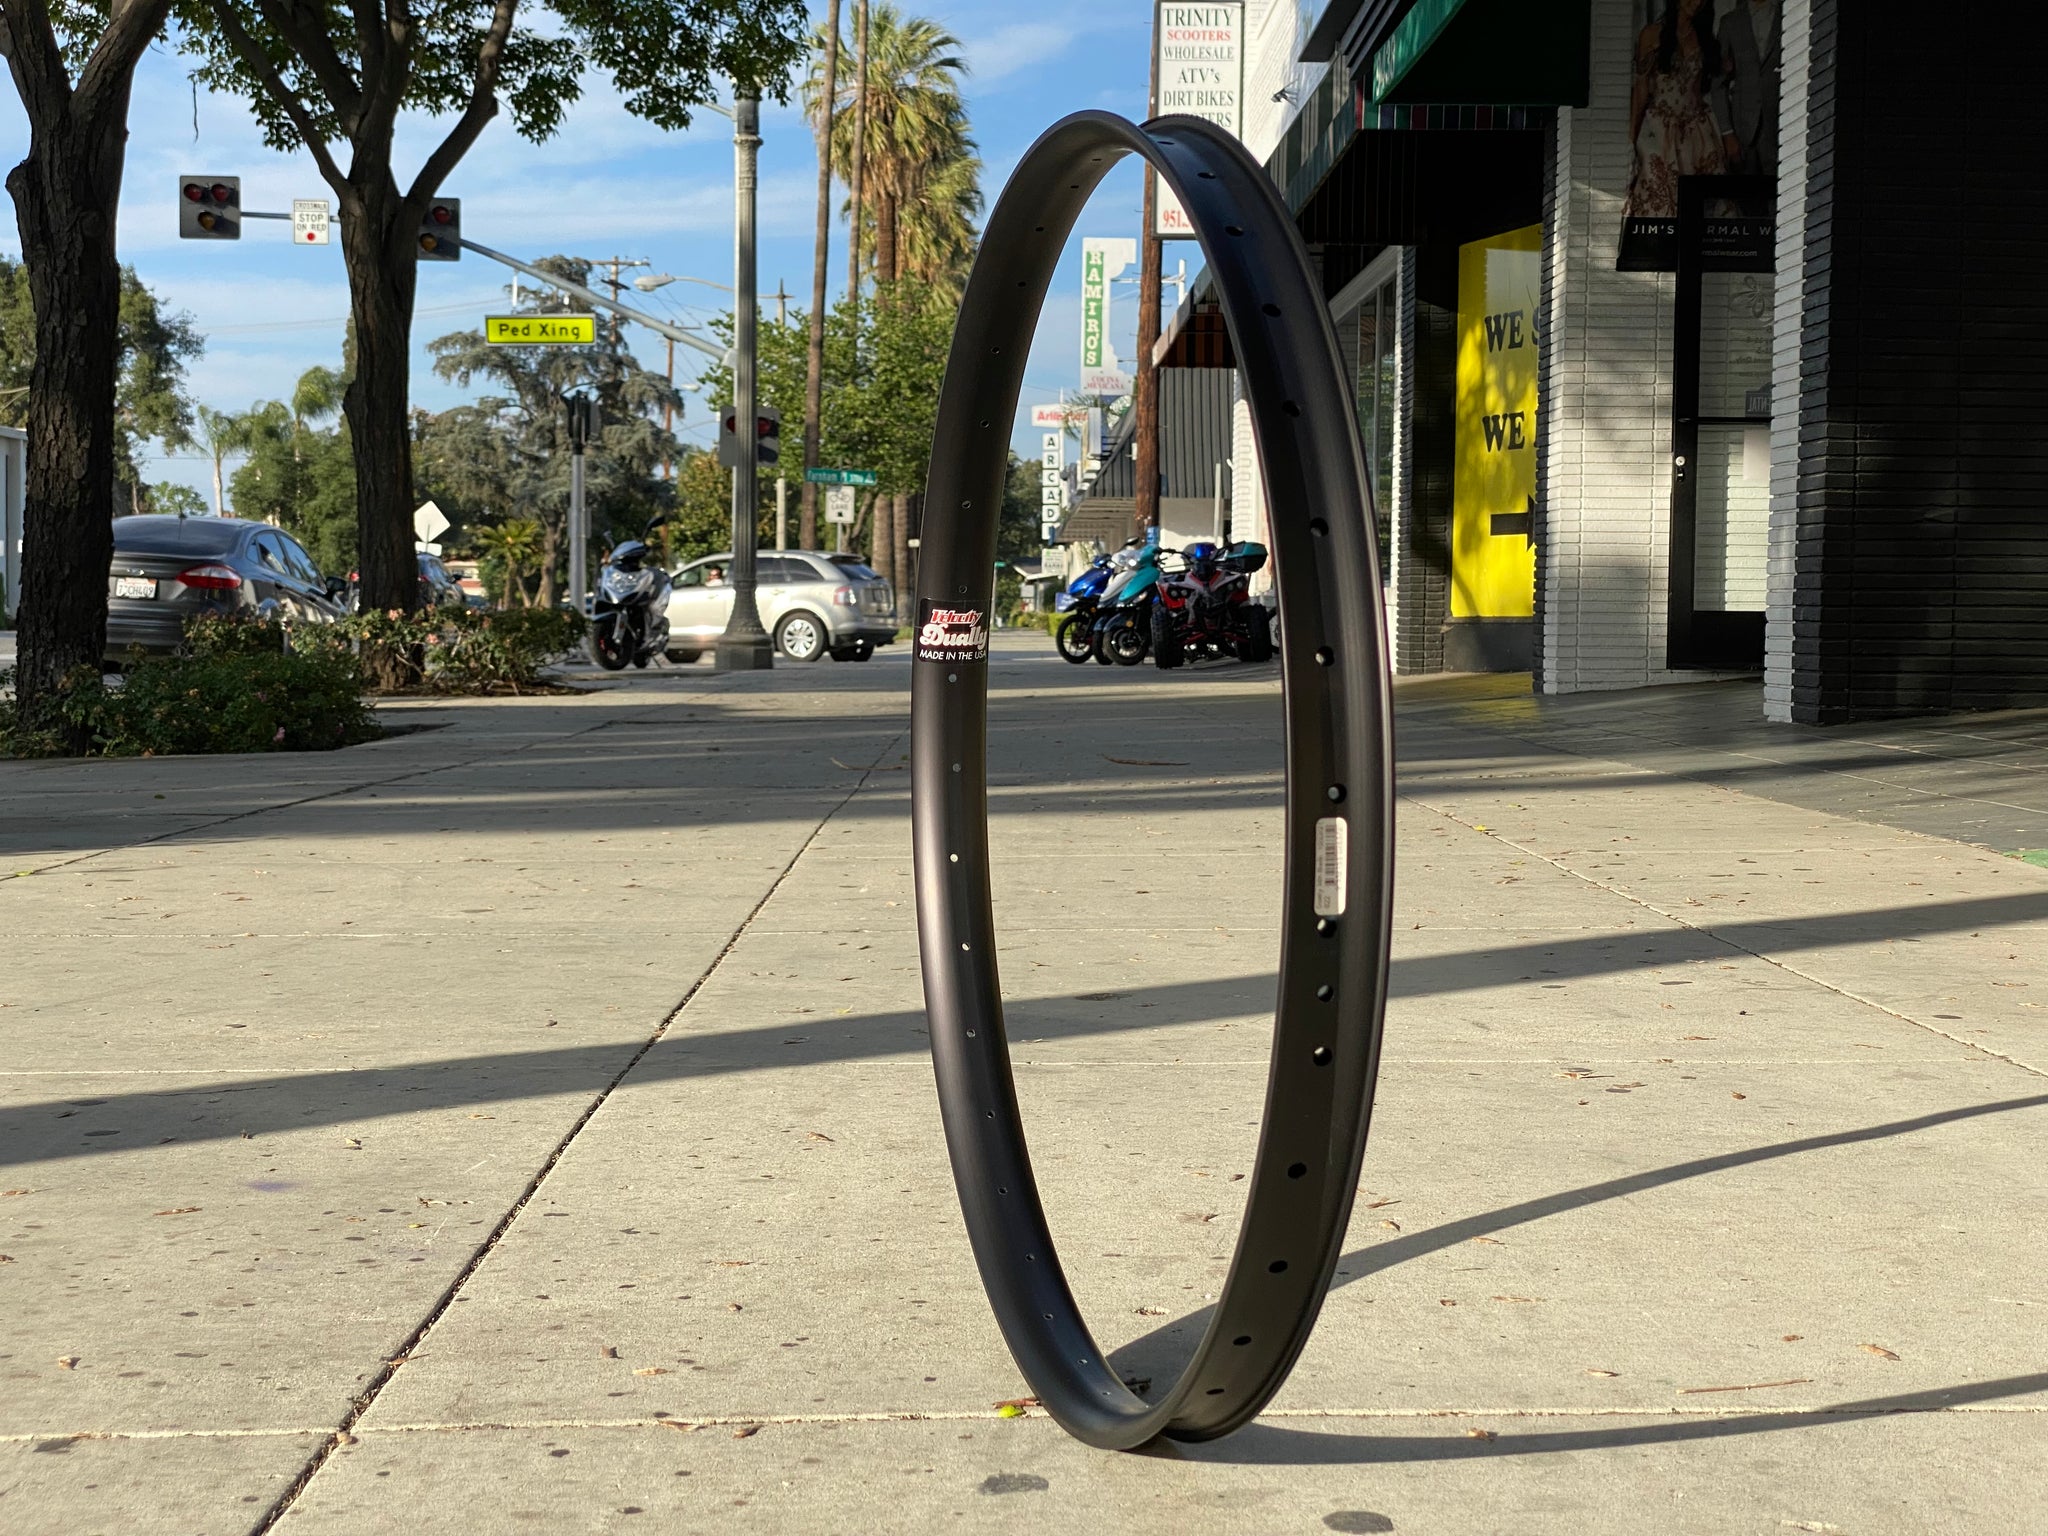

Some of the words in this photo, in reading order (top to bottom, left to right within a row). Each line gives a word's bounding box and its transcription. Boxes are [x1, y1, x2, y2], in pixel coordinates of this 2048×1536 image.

[1163, 8, 1235, 27] TRINITY
[1167, 29, 1231, 41] SCOOTERS
[1164, 46, 1234, 60] WHOLESALE
[1178, 67, 1220, 84] ATV's
[1164, 91, 1194, 107] DIRT
[1197, 90, 1234, 107] BIKES
[299, 213, 324, 223] STOP
[297, 223, 307, 231] ON
[312, 223, 327, 232] RED
[1632, 224, 1675, 235] JIM'S
[1707, 225, 1750, 236] RMAL
[1085, 251, 1103, 366] RAMIRO'S
[499, 323, 530, 337] Ped
[539, 323, 581, 340] Xing
[1485, 309, 1525, 353] WE
[1482, 410, 1525, 453] WE
[930, 608, 983, 626] Velocity
[919, 623, 988, 651] Dually
[919, 650, 944, 660] MADE
[945, 651, 956, 660] IN
[958, 651, 973, 660] THE
[974, 651, 987, 660] USA
